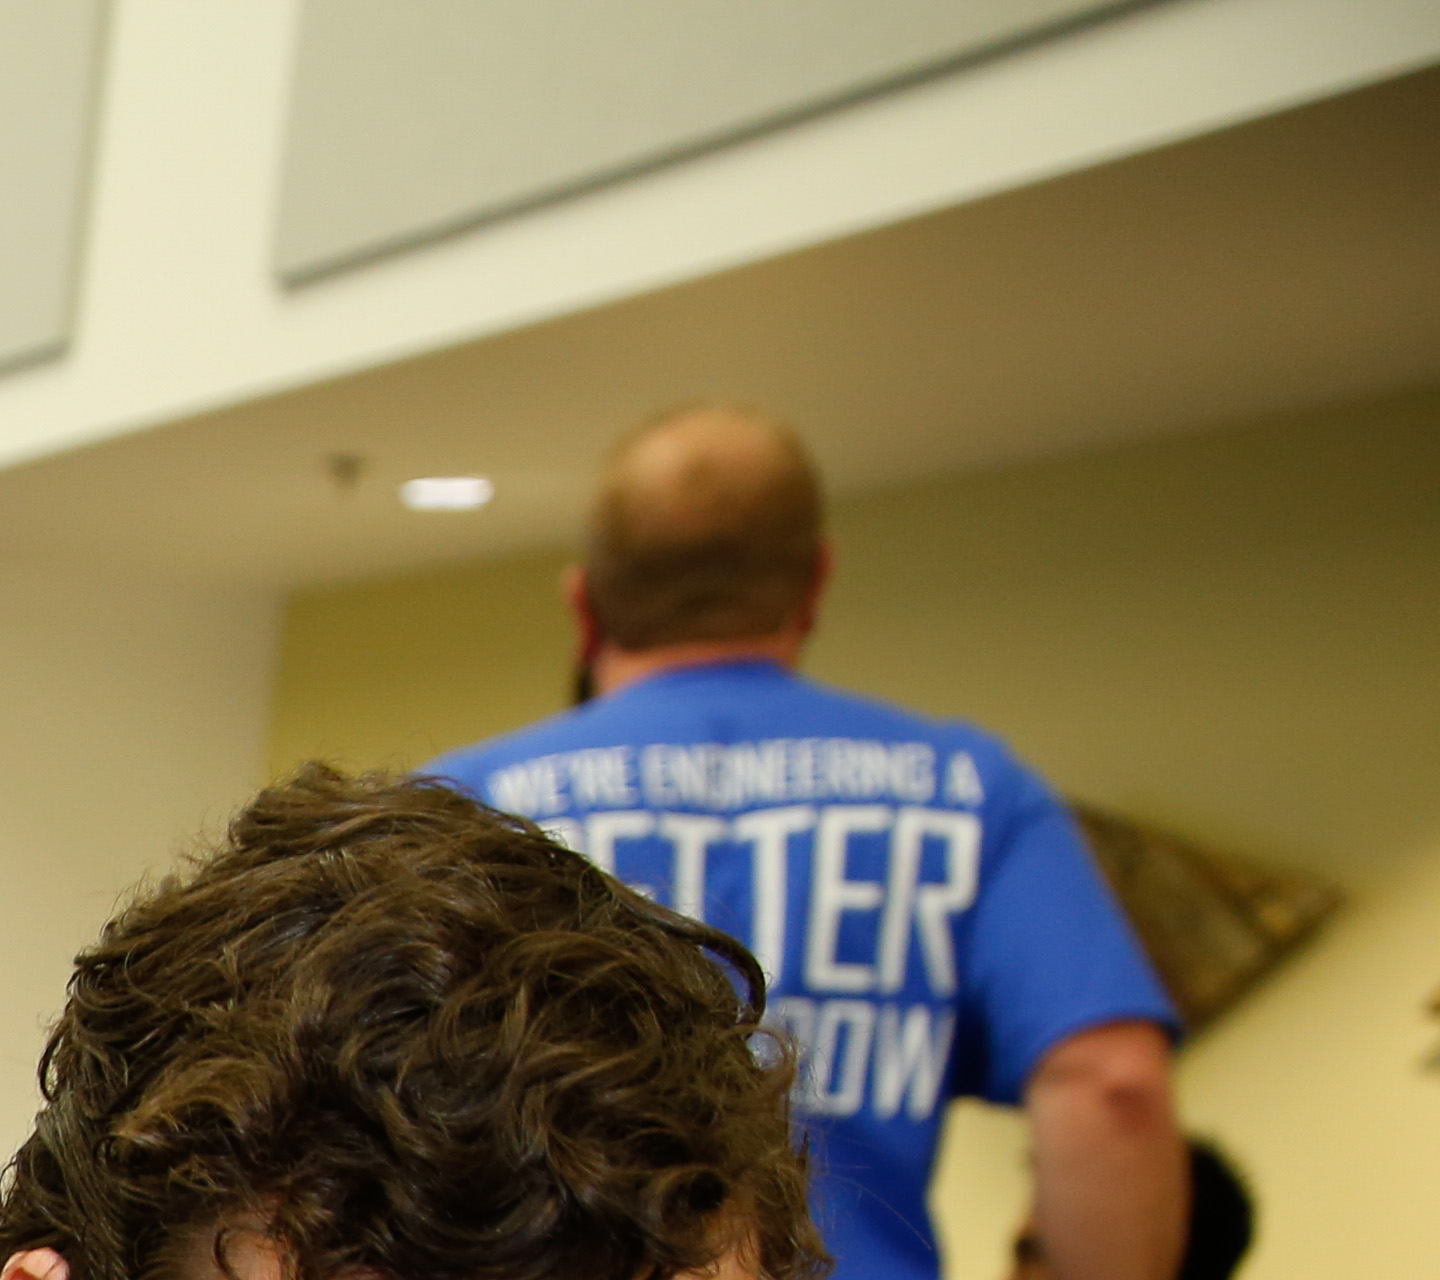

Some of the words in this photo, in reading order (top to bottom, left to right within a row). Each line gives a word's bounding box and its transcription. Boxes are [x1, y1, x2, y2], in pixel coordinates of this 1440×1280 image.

[641, 736, 938, 804] ENGINEERING
[944, 750, 984, 803] A
[542, 805, 982, 997] ETTER
